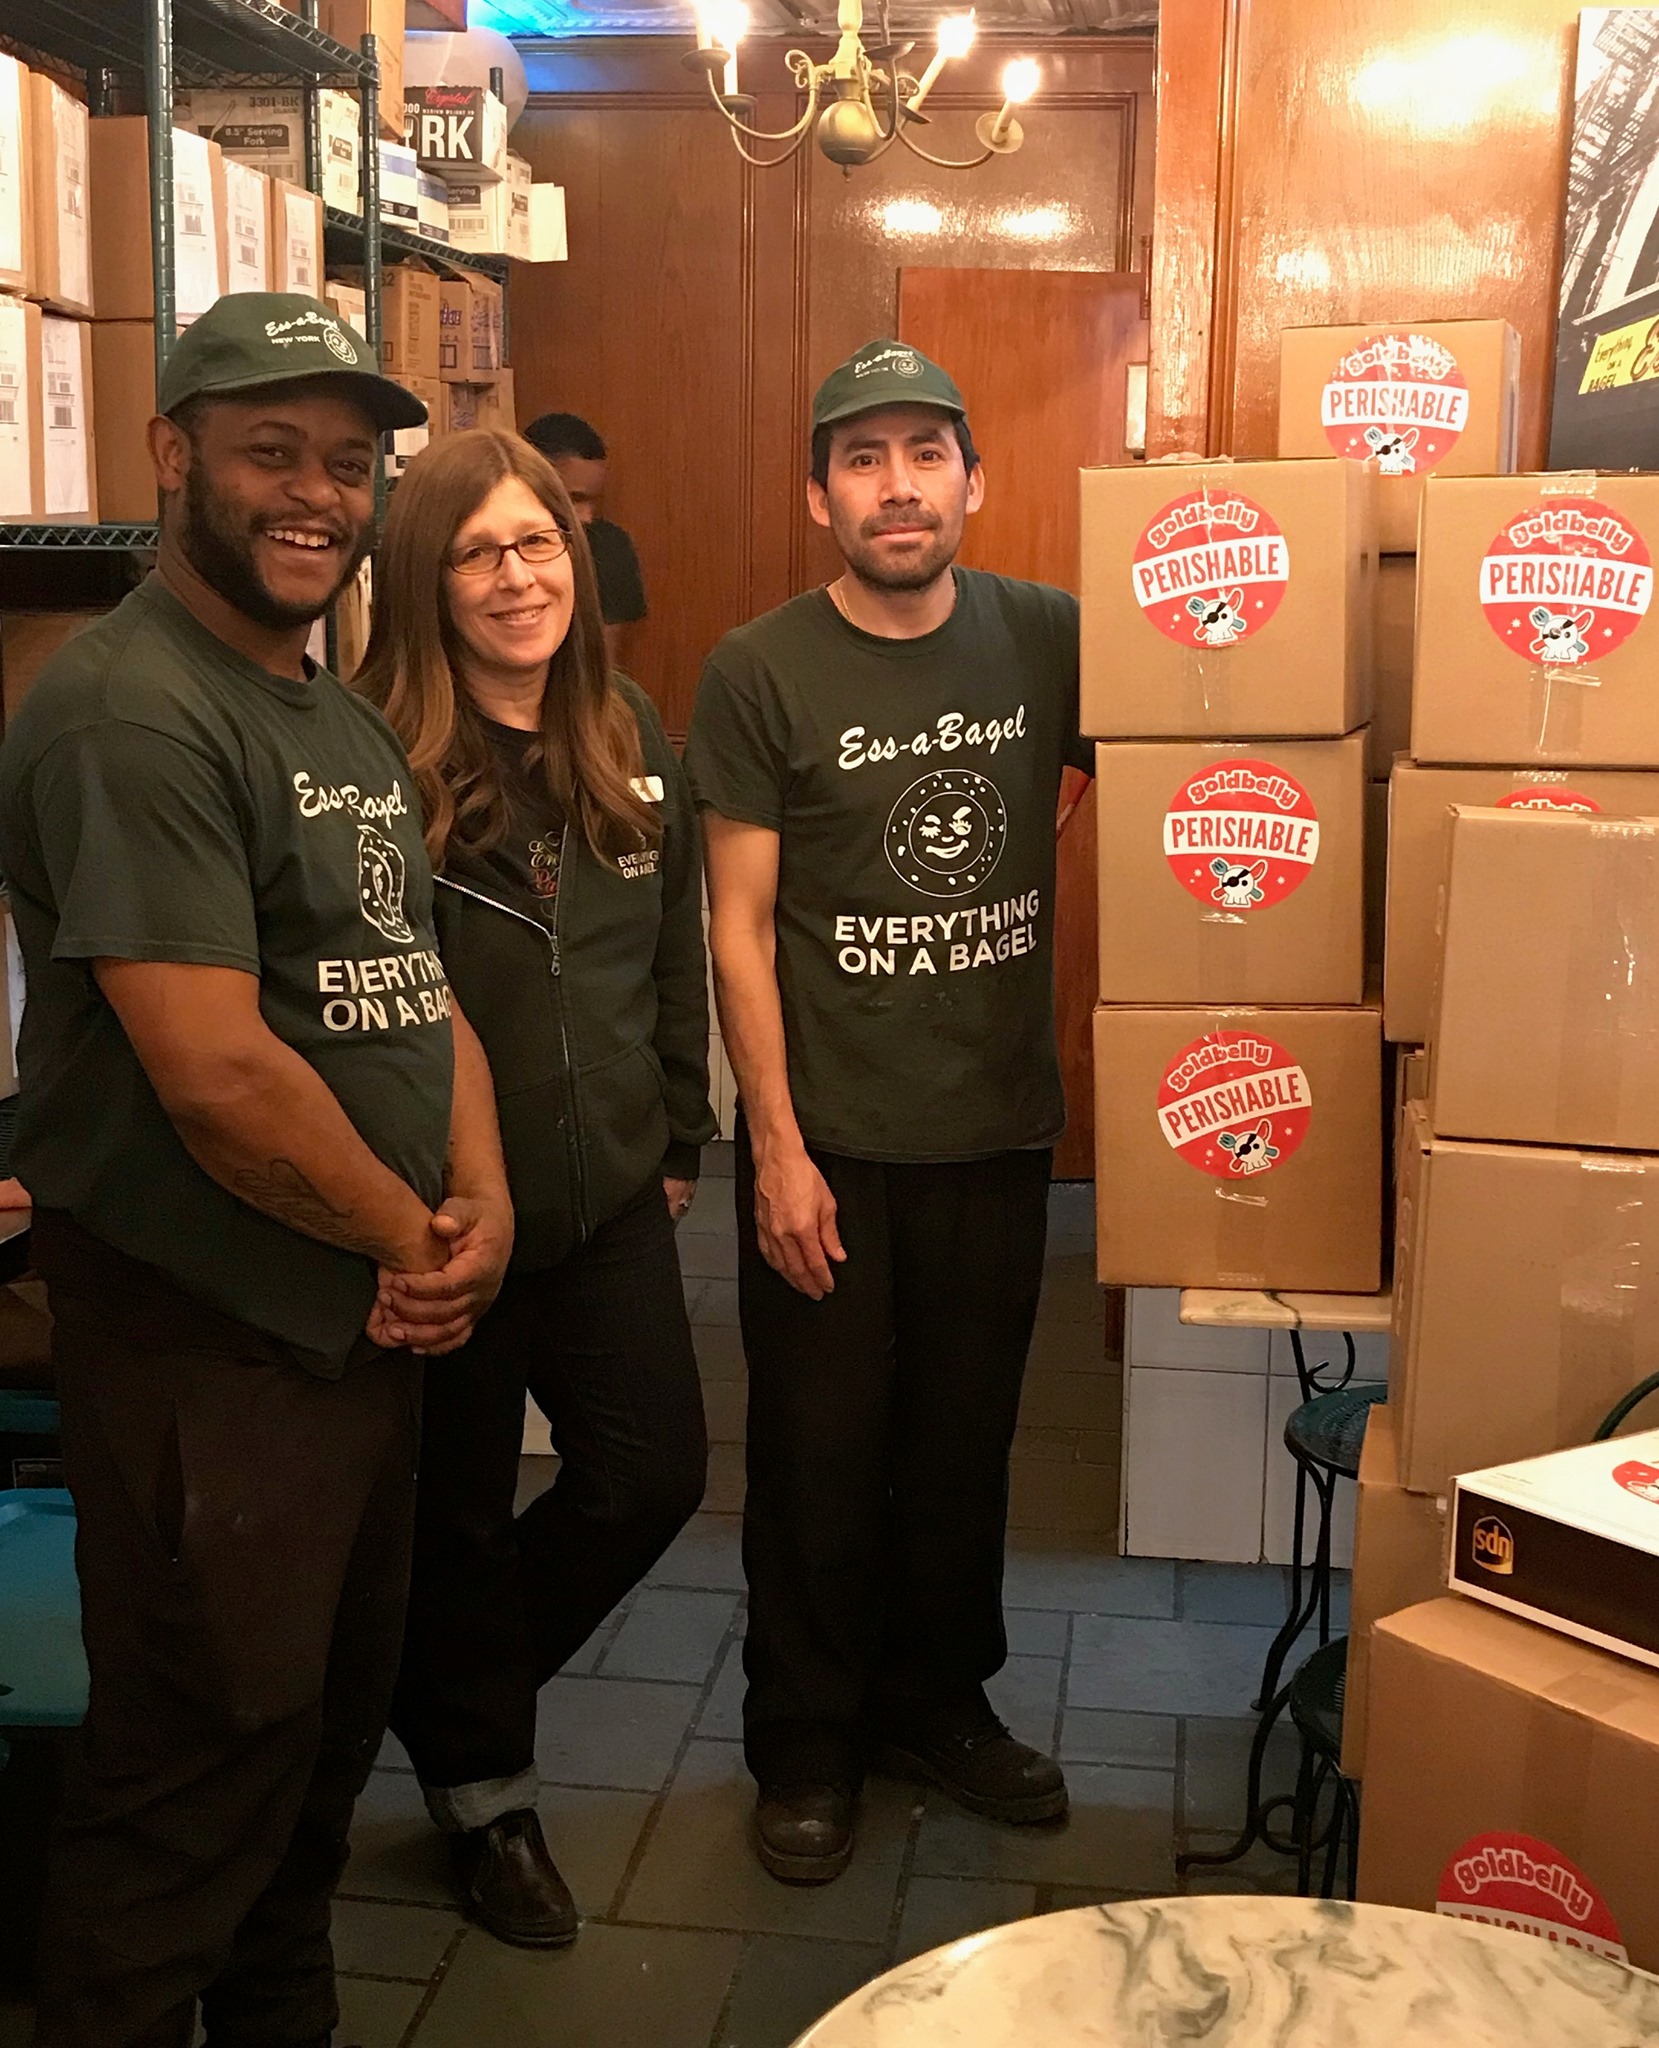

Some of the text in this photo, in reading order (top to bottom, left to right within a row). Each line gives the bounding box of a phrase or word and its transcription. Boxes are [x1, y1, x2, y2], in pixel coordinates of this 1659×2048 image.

[243, 136, 266, 146] Fork
[247, 127, 283, 138] Serving
[421, 115, 474, 159] RK
[448, 187, 476, 197] erving
[448, 195, 461, 203] ork
[271, 335, 321, 345] NEW YORK
[1330, 388, 1462, 424] PERISHABLE
[1147, 500, 1259, 549] goldbelly
[1509, 510, 1634, 555] goldbelly
[1138, 544, 1280, 598] PERISHABLE
[1489, 562, 1646, 606] PERISHABLE
[838, 704, 1027, 770] Ess-a-Bagel
[1187, 770, 1300, 810] goldbelly
[1171, 817, 1313, 857] PERISHABLE
[834, 889, 1039, 944] EVERYTHING
[838, 923, 1038, 976] ON A BAGEL
[322, 998, 389, 1032] ON
[395, 995, 421, 1027] A
[1167, 1040, 1272, 1093] goldbelly
[1164, 1073, 1303, 1139] PERISHABLE
[1454, 1847, 1593, 1921] goldbelly
